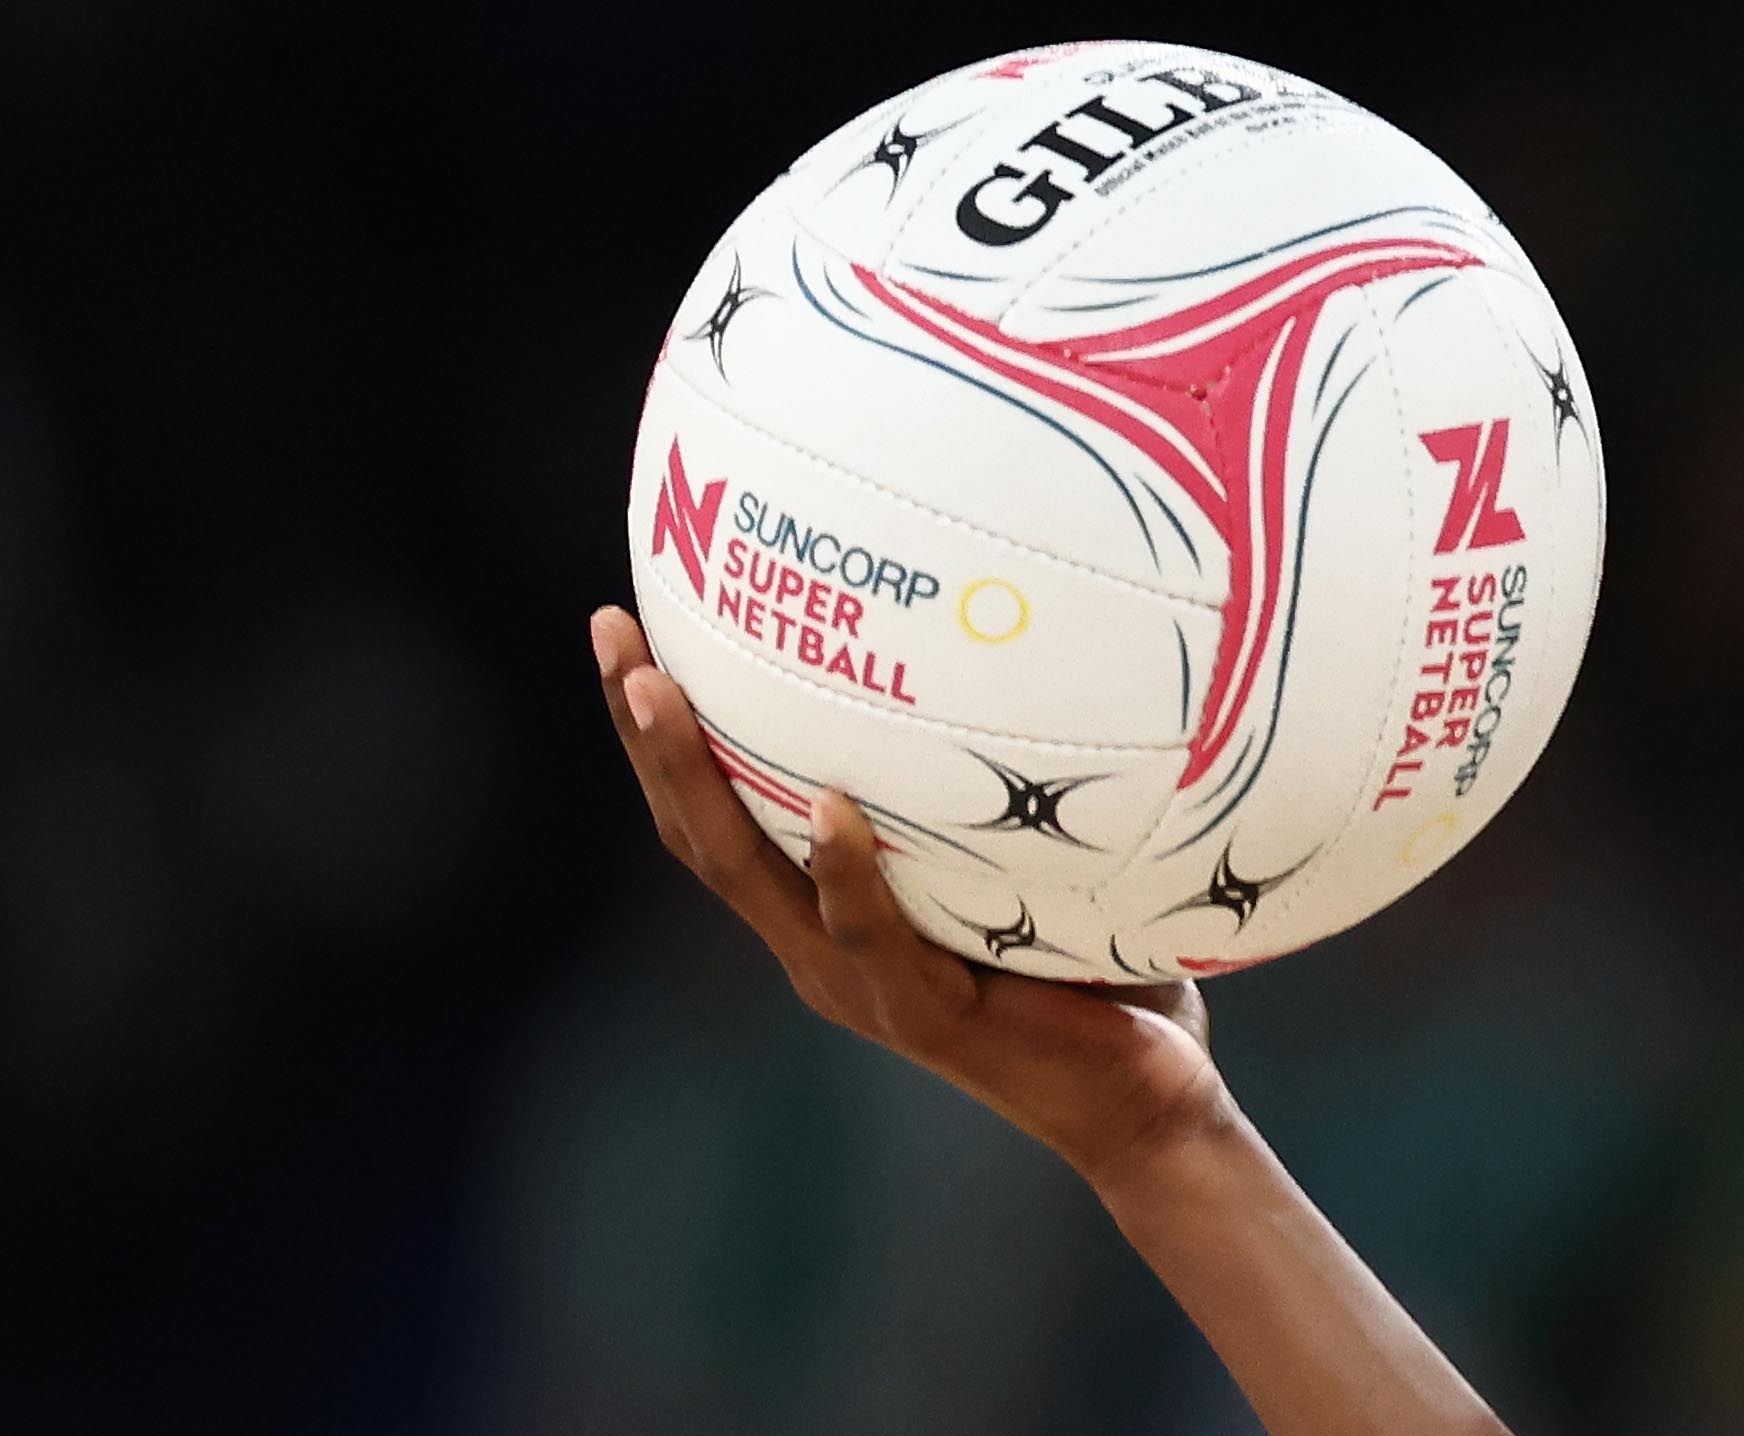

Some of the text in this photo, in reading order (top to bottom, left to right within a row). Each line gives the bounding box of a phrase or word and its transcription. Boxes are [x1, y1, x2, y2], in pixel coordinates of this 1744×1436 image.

[723, 537, 864, 640] SUPER
[733, 491, 940, 608] SUNCORP
[716, 581, 917, 706] NETBALL
[1371, 575, 1462, 813] NETBALL
[1435, 572, 1498, 749] SUPER
[1453, 564, 1528, 798] SUNCORP
